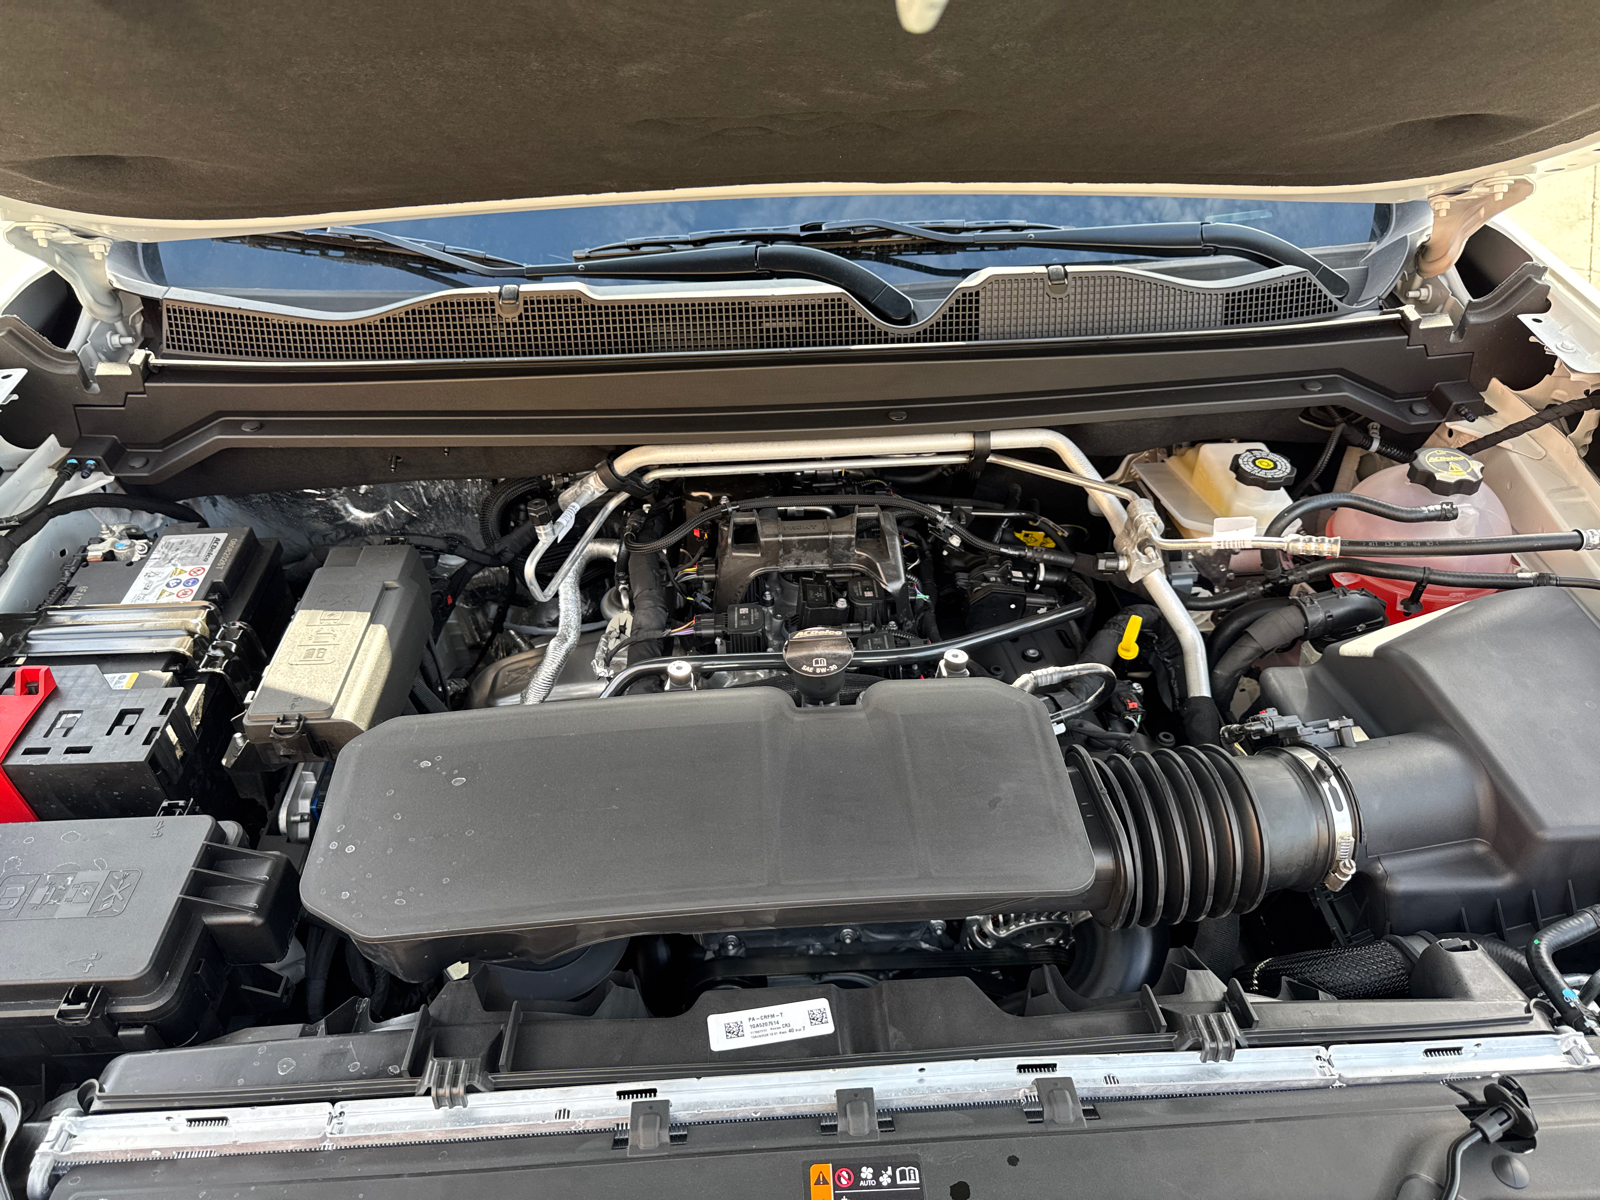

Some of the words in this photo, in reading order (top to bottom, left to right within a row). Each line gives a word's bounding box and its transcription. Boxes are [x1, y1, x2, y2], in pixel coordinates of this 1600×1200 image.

[203, 536, 221, 563] ACDelco
[793, 630, 843, 638] ACDelco
[801, 665, 815, 673] SAE
[815, 664, 838, 673] 5W-30
[859, 1179, 877, 1187] AUTO
